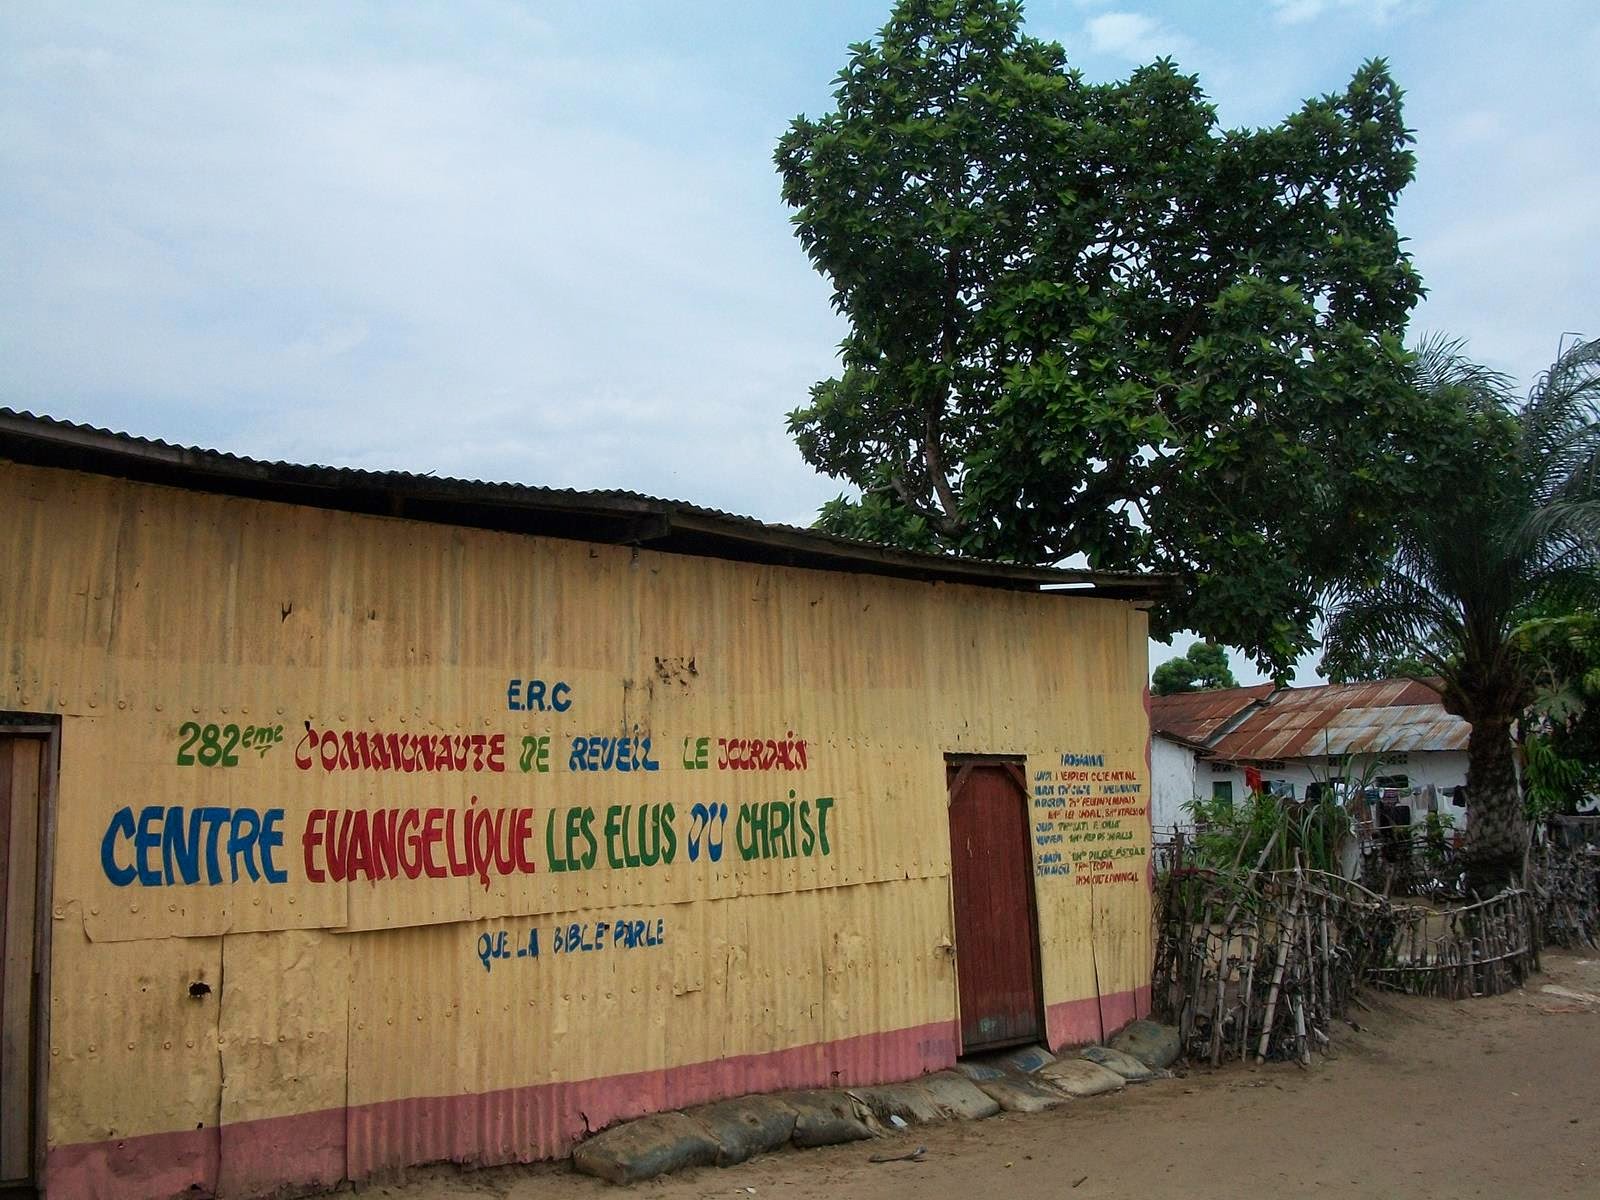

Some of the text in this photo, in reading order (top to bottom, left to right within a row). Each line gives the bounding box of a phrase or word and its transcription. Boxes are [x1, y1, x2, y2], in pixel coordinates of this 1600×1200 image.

[507, 679, 572, 712] E.R.C
[295, 728, 505, 773] COMMUNAUTE
[519, 736, 550, 773] DE
[569, 724, 659, 772] REVEIL
[682, 736, 711, 770] LE
[717, 730, 808, 771] JOURDAIN
[100, 789, 834, 893] CENTRE EVANGELIQUE LES ELUS DU CHRIST
[477, 918, 664, 972] QUE LA BIBLE PARLE
